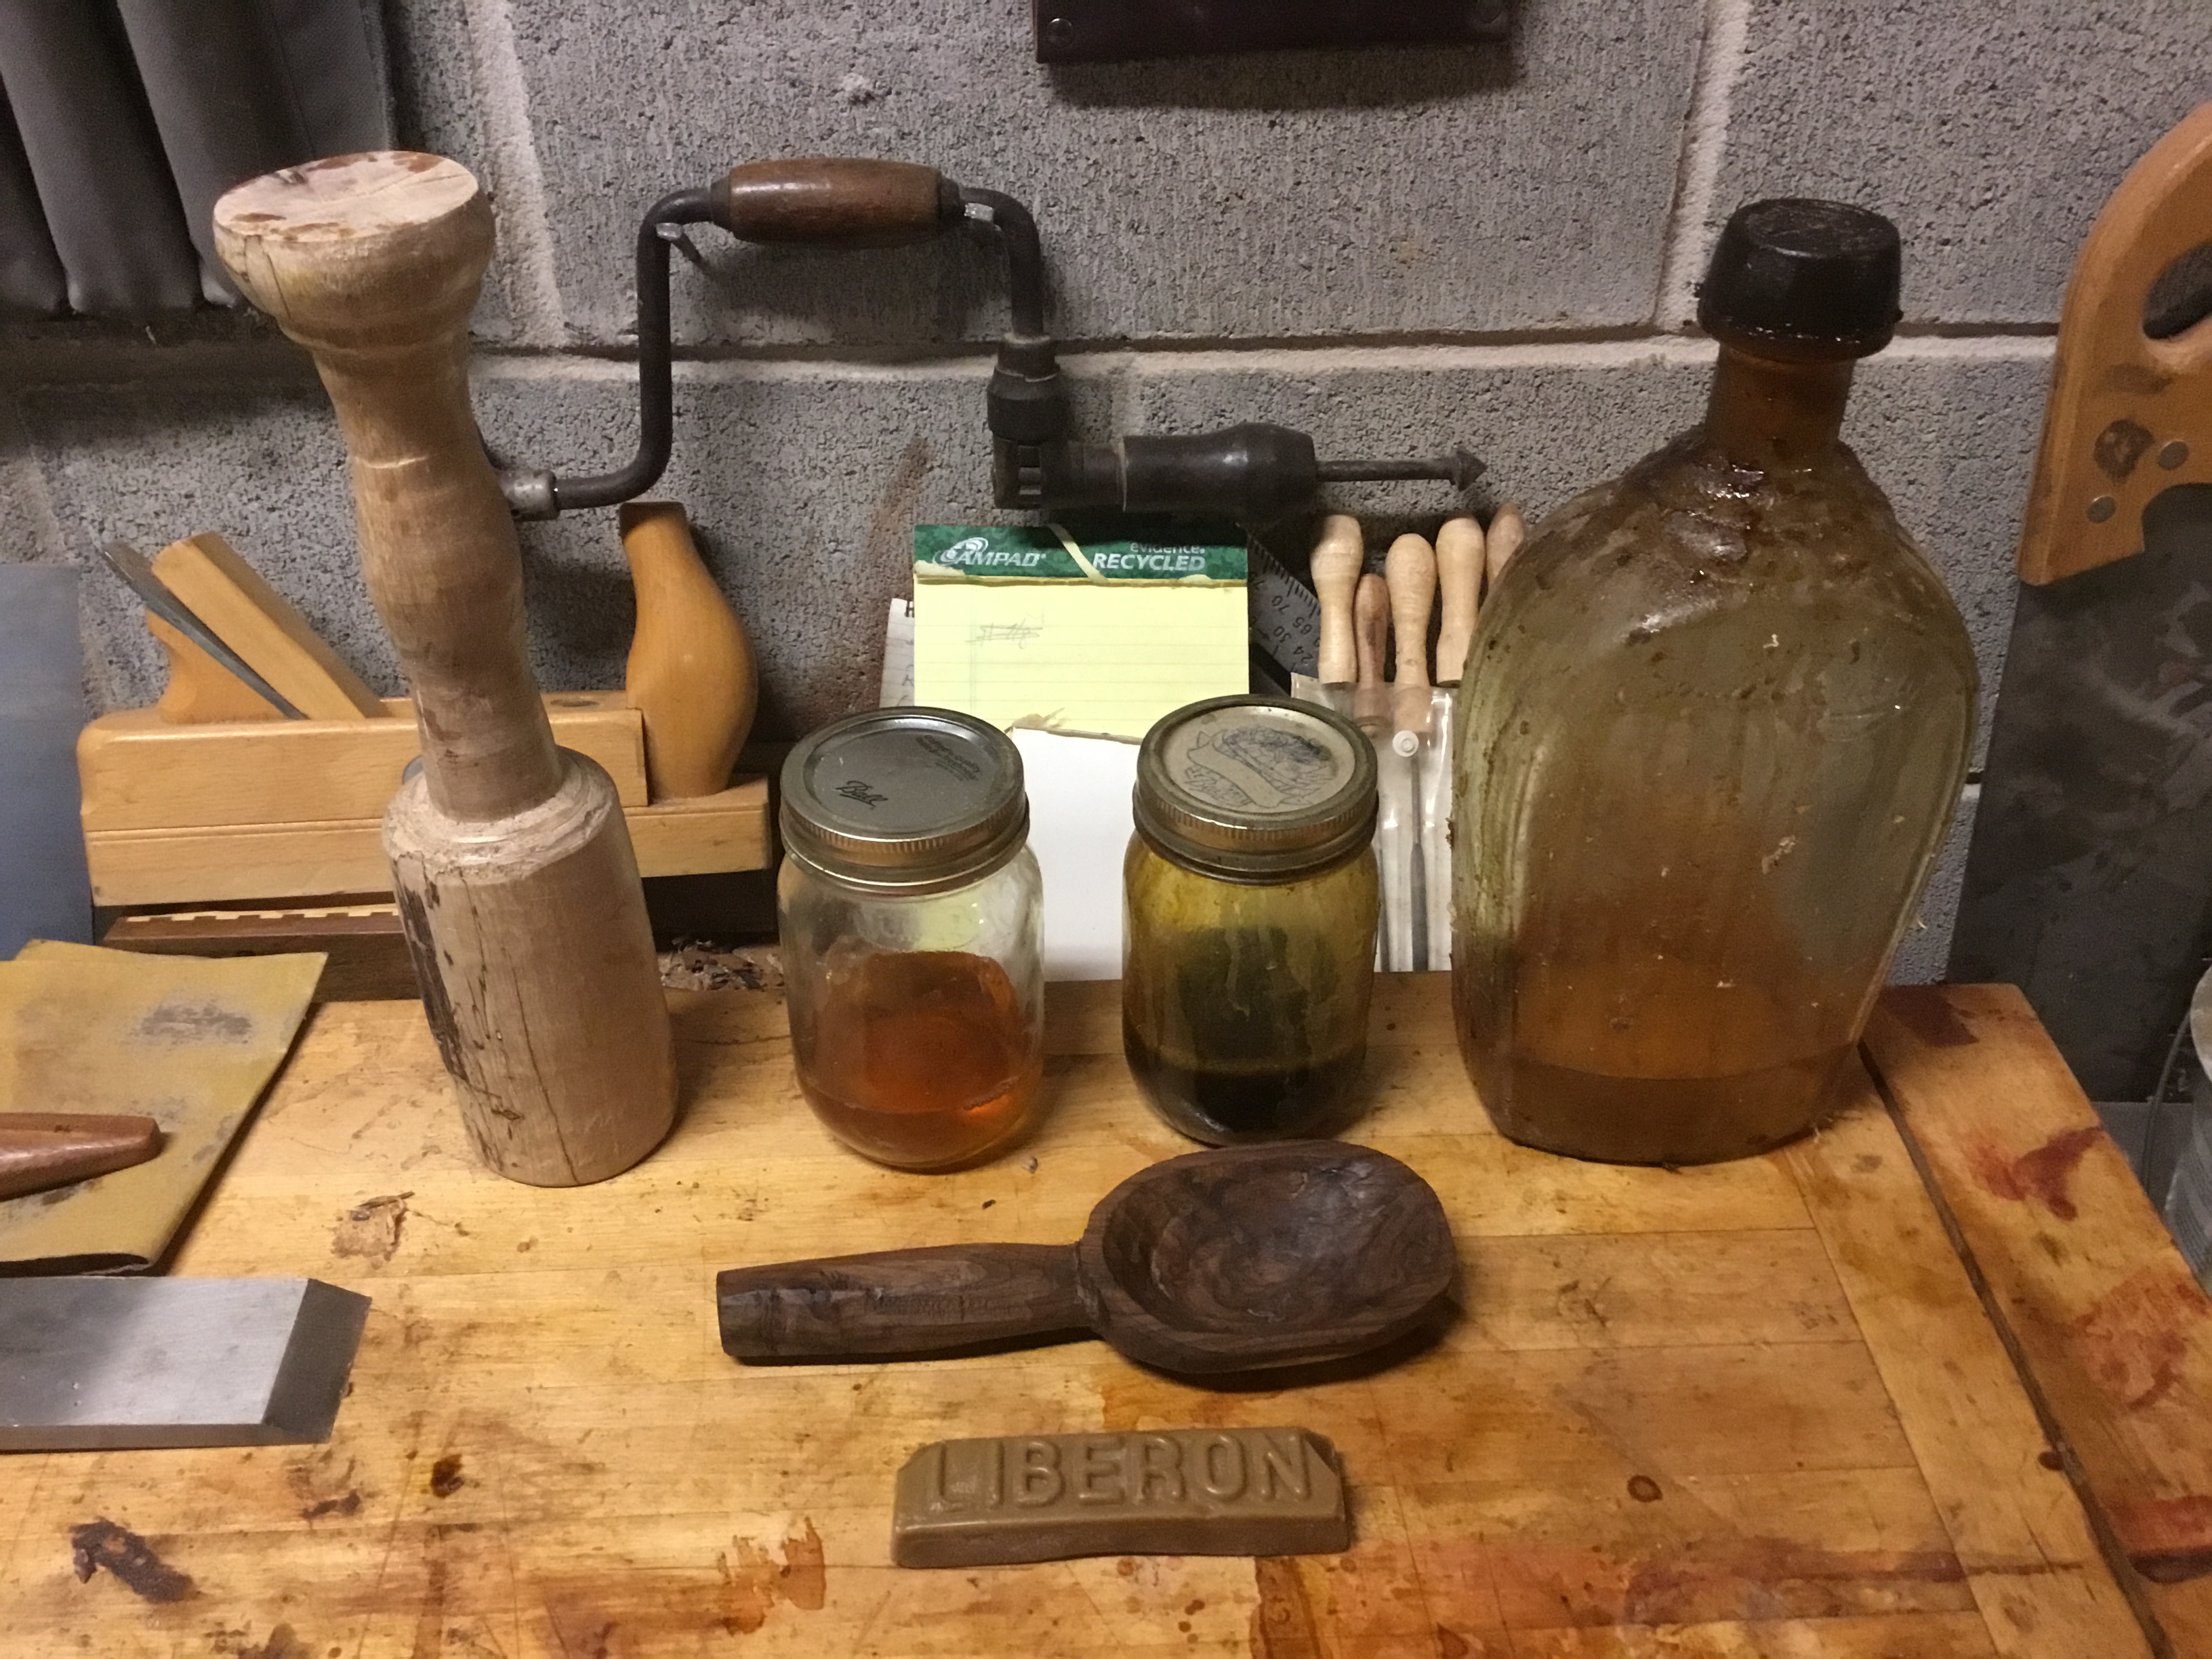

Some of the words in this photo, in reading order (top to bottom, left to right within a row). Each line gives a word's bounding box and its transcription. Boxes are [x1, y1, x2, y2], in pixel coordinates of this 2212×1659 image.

[956, 551, 1041, 567] AMPAD
[1093, 553, 1205, 571] RECYCLED
[1271, 596, 1290, 615] 70
[1273, 626, 1292, 643] 30
[1292, 617, 1313, 635] 65
[1293, 646, 1314, 664] 24
[835, 780, 888, 807] Ball
[932, 1432, 1313, 1513] LIBERON
